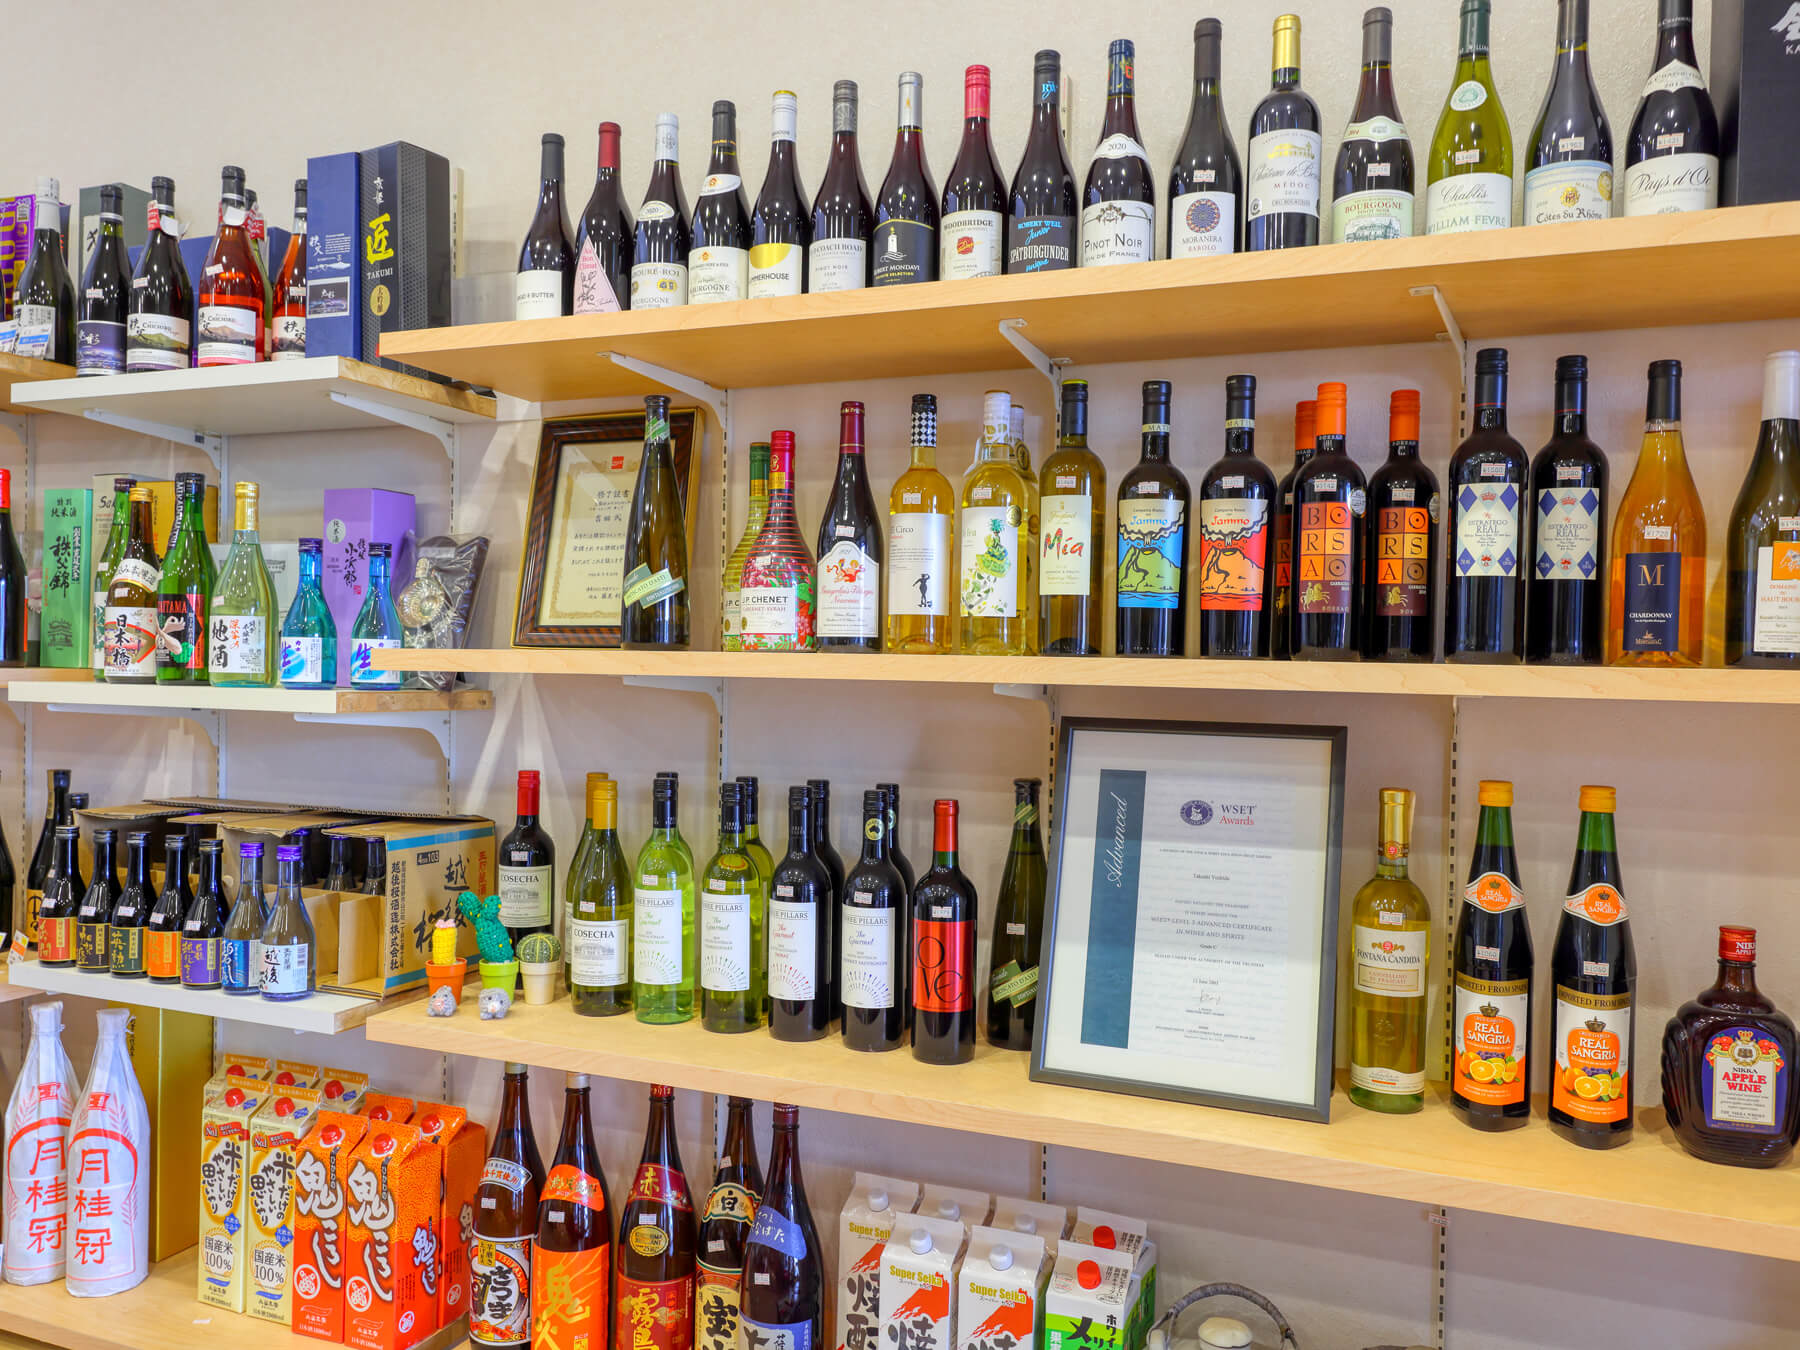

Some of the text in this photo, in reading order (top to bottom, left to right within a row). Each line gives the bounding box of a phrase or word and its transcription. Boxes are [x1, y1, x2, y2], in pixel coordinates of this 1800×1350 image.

[1107, 143, 1127, 152] 2020
[1631, 166, 1711, 196] Pays d'Oc
[1440, 183, 1489, 203] Chablis
[1345, 201, 1403, 214] BOURGOGNE
[1536, 207, 1603, 224] Côtes du Rhône
[943, 218, 993, 232] WOODBRIDGE
[1017, 219, 1062, 230] ROBERT WEIL
[1427, 216, 1470, 233] WILLIAM
[365, 212, 395, 265] 匠
[1025, 226, 1051, 246] Junior
[1084, 233, 1144, 251] PINOT NOIR
[1108, 249, 1142, 259] FRANCE
[367, 268, 394, 280] TAKUMI
[889, 264, 920, 272] MONDAVI
[532, 291, 555, 299] BUTTER
[99, 495, 116, 510] Sa
[1130, 515, 1168, 526] Jammo
[1211, 515, 1249, 526] Jammo
[1467, 519, 1509, 527] ESTRATEGO
[895, 525, 914, 534] Circo
[1476, 525, 1499, 534] REAL
[1556, 529, 1579, 538] REAL
[343, 541, 359, 588] 小次郎
[1637, 564, 1665, 586] M
[751, 595, 788, 604] CHENET
[113, 613, 131, 667] 日本橋
[211, 619, 229, 669] 地酒
[1221, 804, 1256, 815] WSET
[1219, 815, 1256, 826] Awards
[1105, 791, 1130, 888] Advanced
[650, 898, 674, 907] PILLARS
[1480, 893, 1508, 905] SANGRIA
[1594, 900, 1612, 908] REAL
[714, 903, 743, 912] PILLARS
[781, 911, 809, 919] PILLARS
[1587, 904, 1617, 915] SANGRIA
[858, 916, 889, 925] PILLARS
[573, 928, 615, 940] COSECHA
[1356, 947, 1421, 965] FONTANA CANDIDA
[1487, 984, 1511, 995] FROM
[1593, 997, 1618, 1008] FROM
[1474, 1021, 1504, 1035] REAL
[1466, 1029, 1512, 1045] SANGRIA
[1580, 1036, 1610, 1051] REAL
[1570, 1044, 1618, 1060] SANGRIA
[1722, 1071, 1767, 1085] APPLE
[1732, 1066, 1758, 1075] NIKKA
[1727, 1081, 1763, 1094] WINE
[212, 1152, 226, 1202] やさしい
[222, 1141, 243, 1209] 米だけの
[639, 1166, 661, 1197] 赤
[202, 1162, 219, 1215] 思いやり
[261, 1163, 277, 1213] やさしい
[273, 1152, 296, 1220] 米だけの
[25, 1136, 68, 1257] 月桂冠
[250, 1174, 269, 1227] 思いやり
[73, 1147, 114, 1265] 月桂冠
[295, 1150, 344, 1289] 鬼ころし
[347, 1160, 396, 1303] 鬼ころし
[848, 1221, 873, 1237] Super
[204, 1236, 233, 1256] 国産米
[205, 1251, 232, 1271] 100%
[253, 1249, 287, 1269] 国産米
[412, 1226, 437, 1295] 鬼ころし
[253, 1264, 285, 1284] 100%
[889, 1264, 943, 1291] Super Seika
[488, 1265, 513, 1320] さつま
[968, 1282, 1027, 1308] Super Seika
[703, 1294, 739, 1350] 宝
